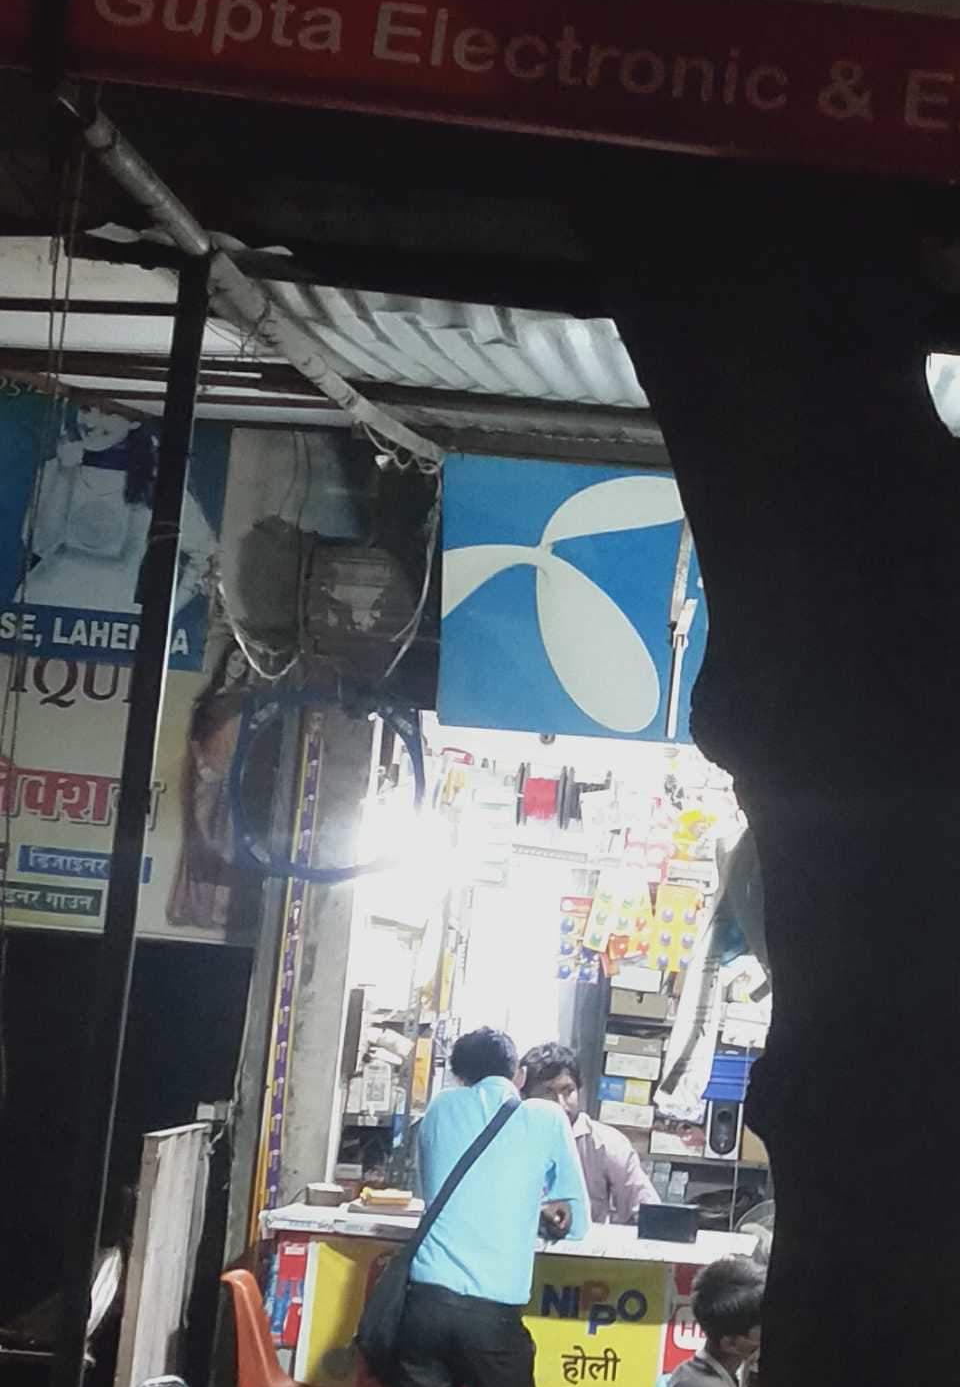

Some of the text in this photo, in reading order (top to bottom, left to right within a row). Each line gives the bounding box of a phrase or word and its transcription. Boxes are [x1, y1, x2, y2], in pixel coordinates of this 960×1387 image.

[371, 0, 789, 111] Electronic
[815, 60, 873, 123] &
[52, 617, 190, 656] LAHEA
[10, 655, 132, 708] IQU
[541, 1280, 648, 1335] NIPPO
[561, 1345, 621, 1385] होली
